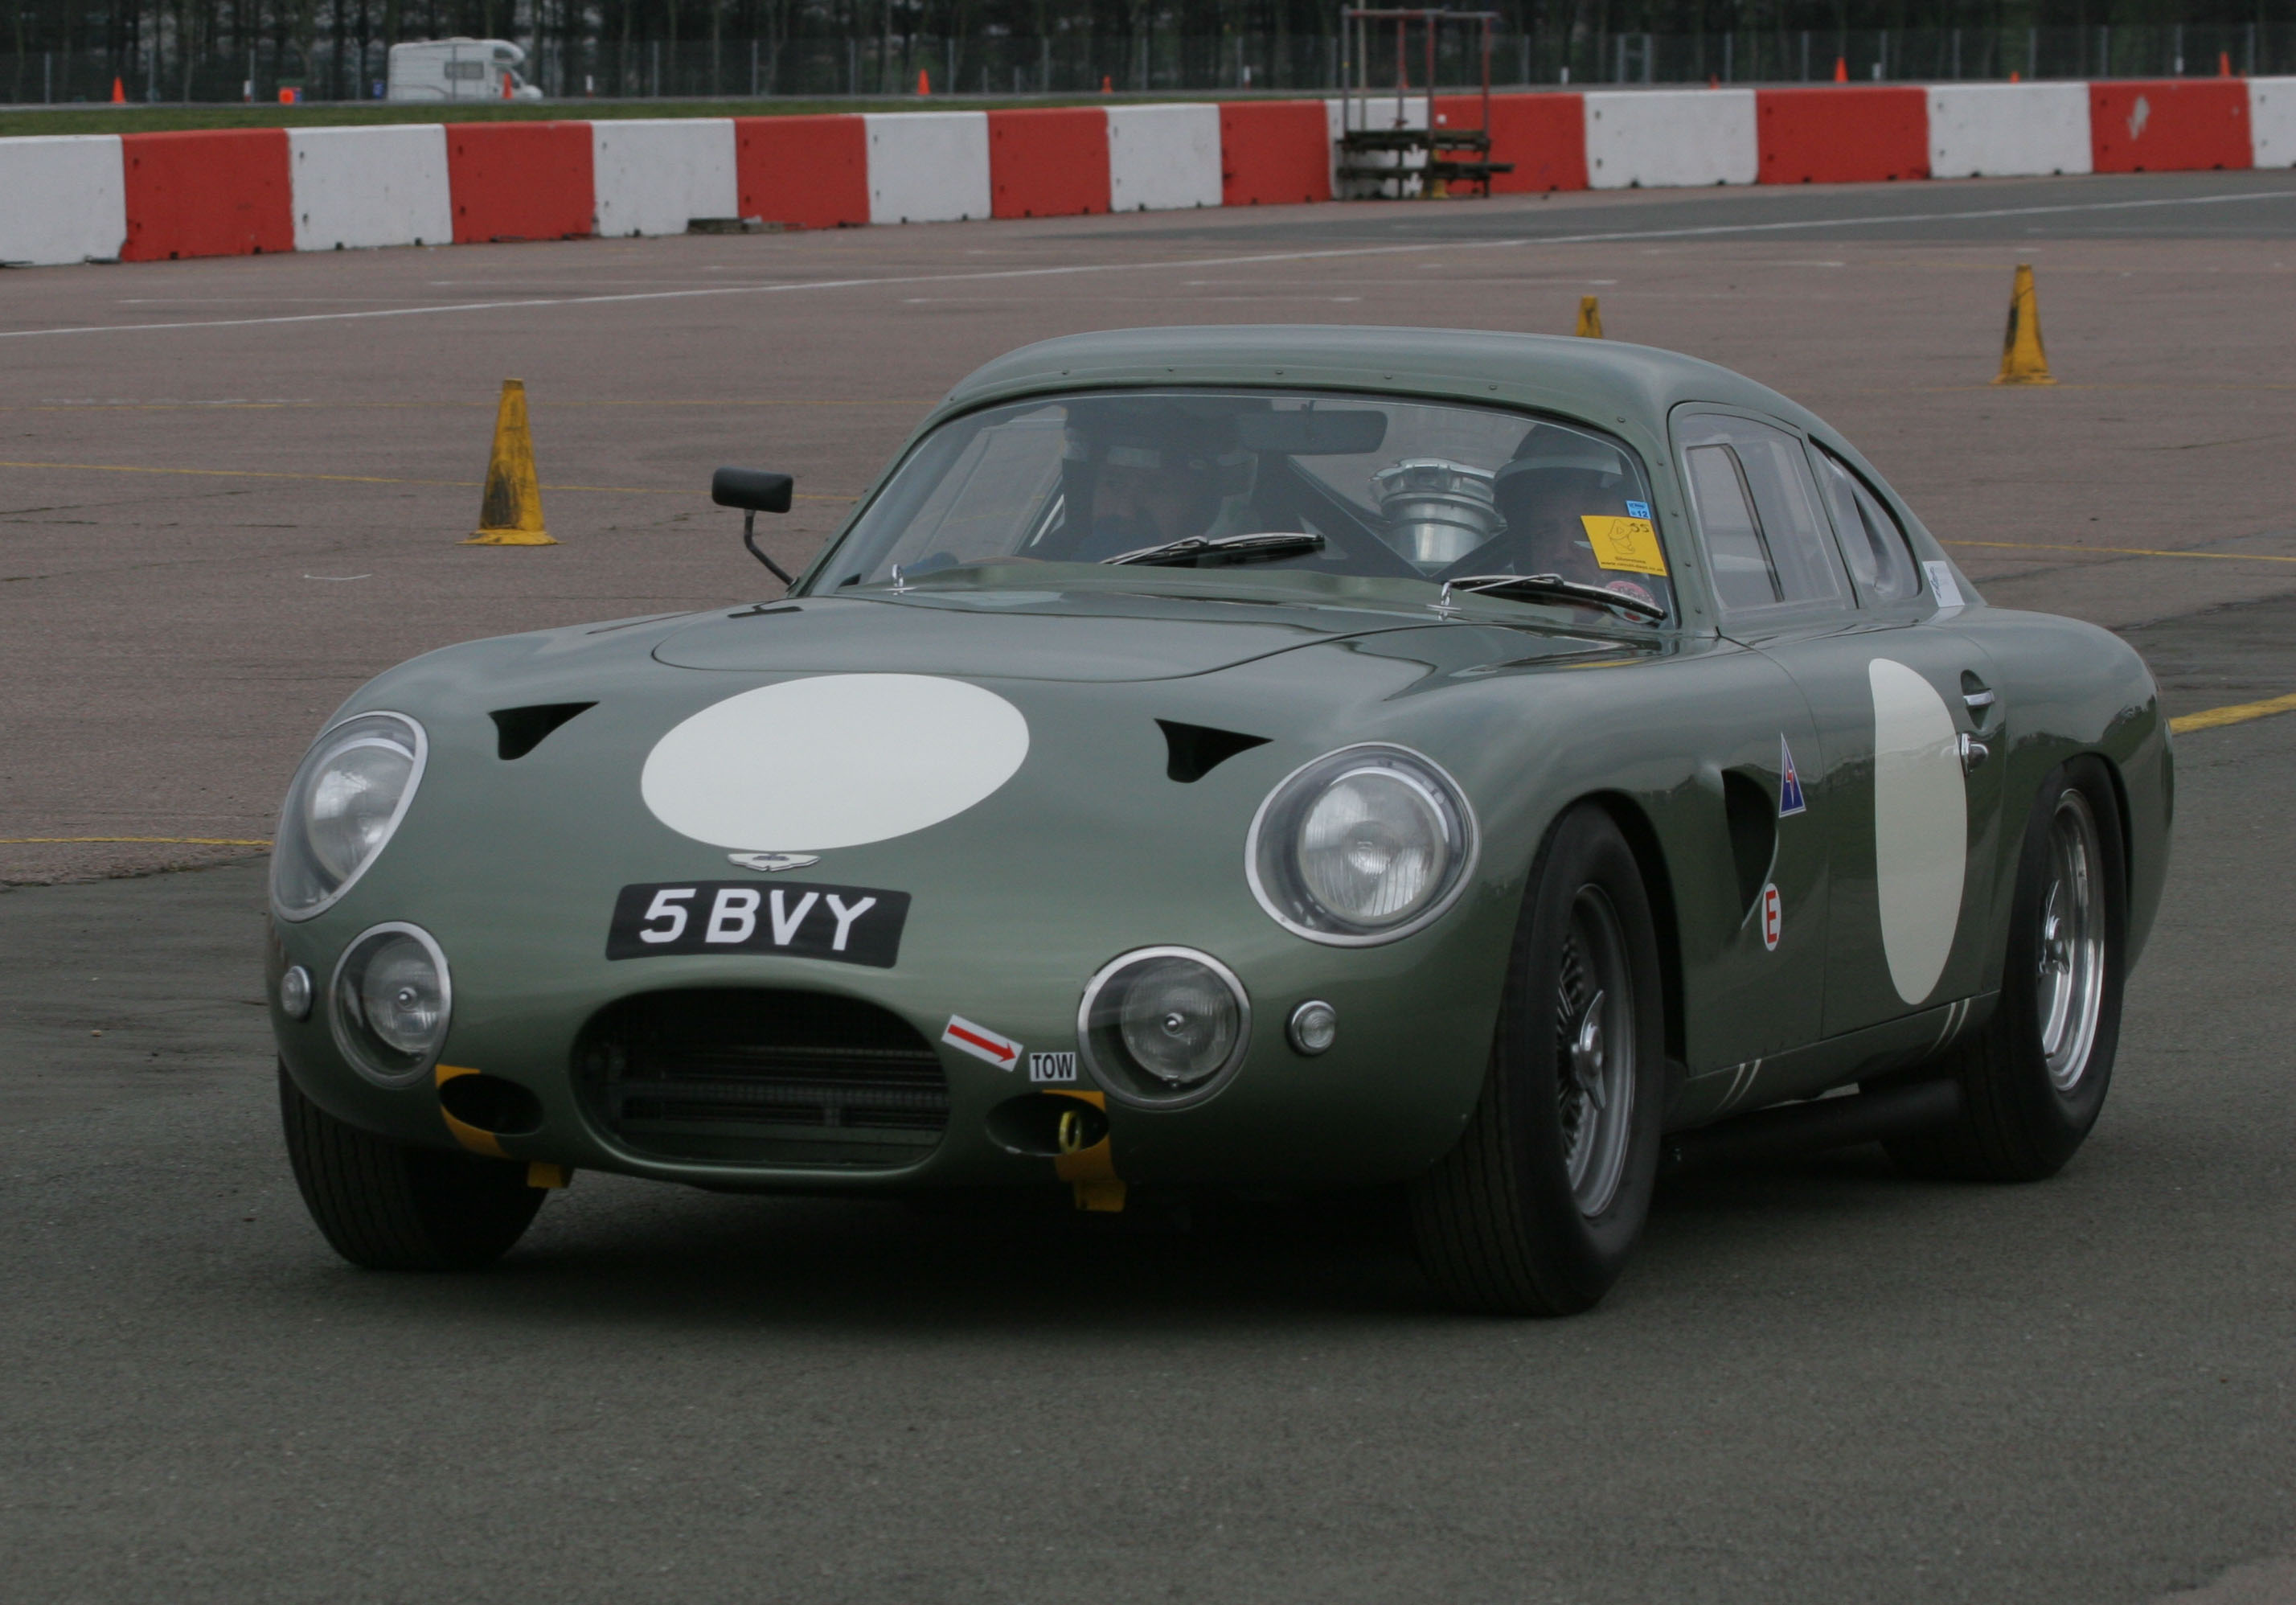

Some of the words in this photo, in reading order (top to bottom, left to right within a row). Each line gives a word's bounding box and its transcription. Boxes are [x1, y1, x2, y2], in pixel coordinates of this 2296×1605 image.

[1637, 510, 1649, 518] 12
[640, 889, 696, 944] 5
[705, 889, 877, 951] BVY
[1766, 890, 1777, 943] E
[1032, 1054, 1074, 1079] TOW
